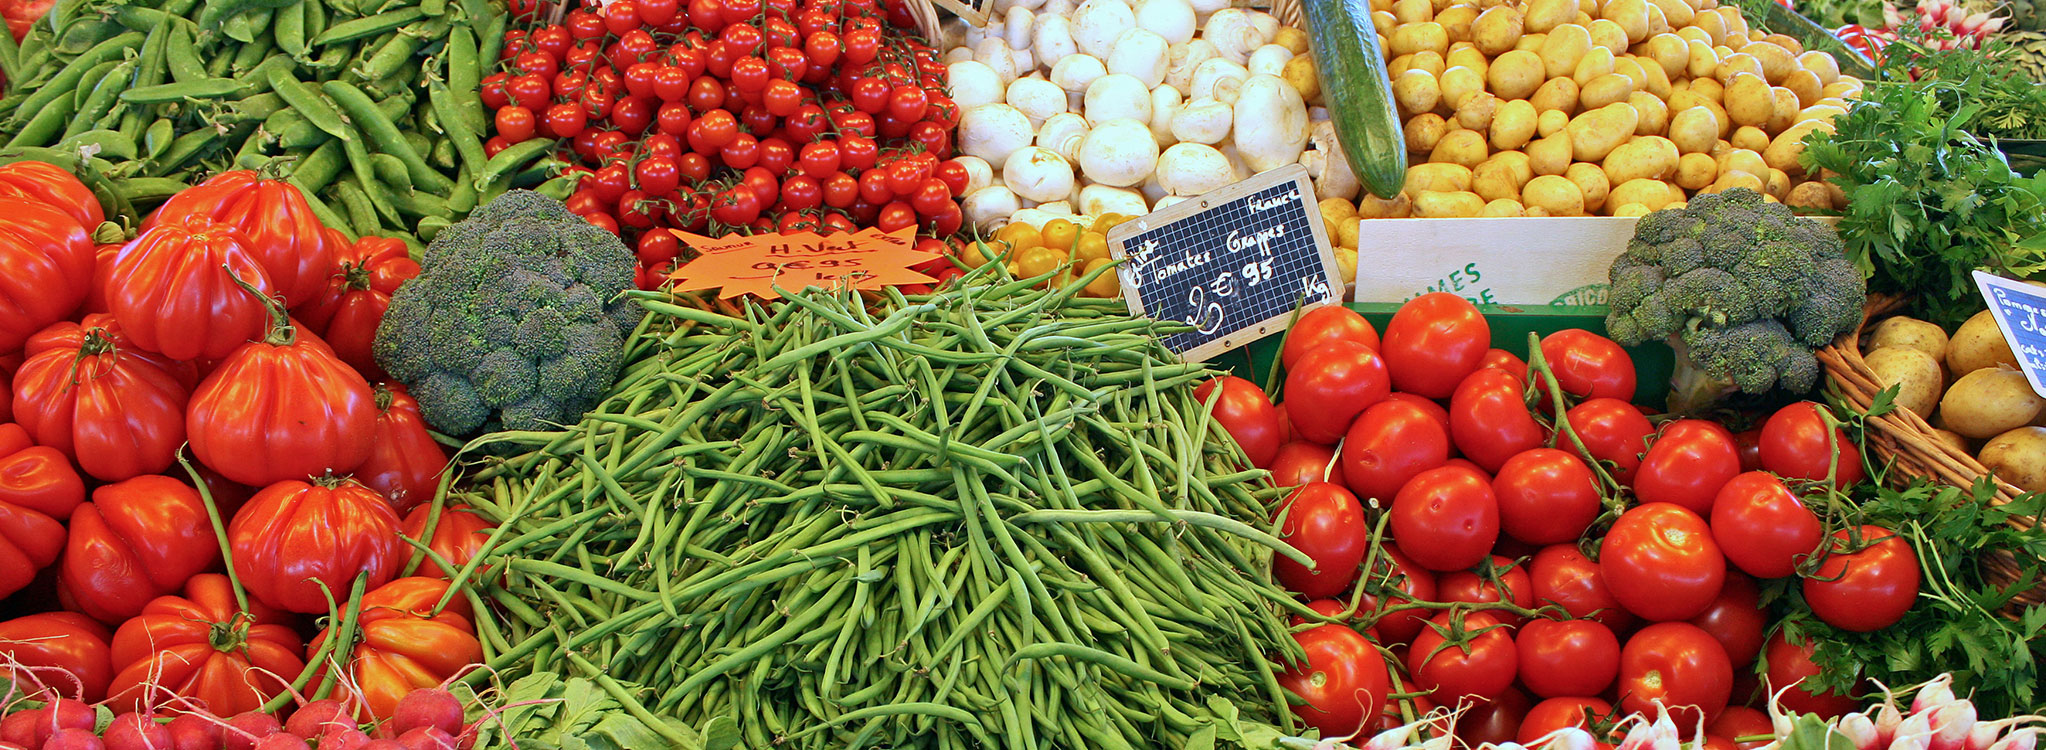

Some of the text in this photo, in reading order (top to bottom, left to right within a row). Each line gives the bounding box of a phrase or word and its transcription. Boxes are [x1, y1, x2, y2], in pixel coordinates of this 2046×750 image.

[1248, 189, 1302, 215] France
[1141, 224, 1286, 285] Tomates Grappes
